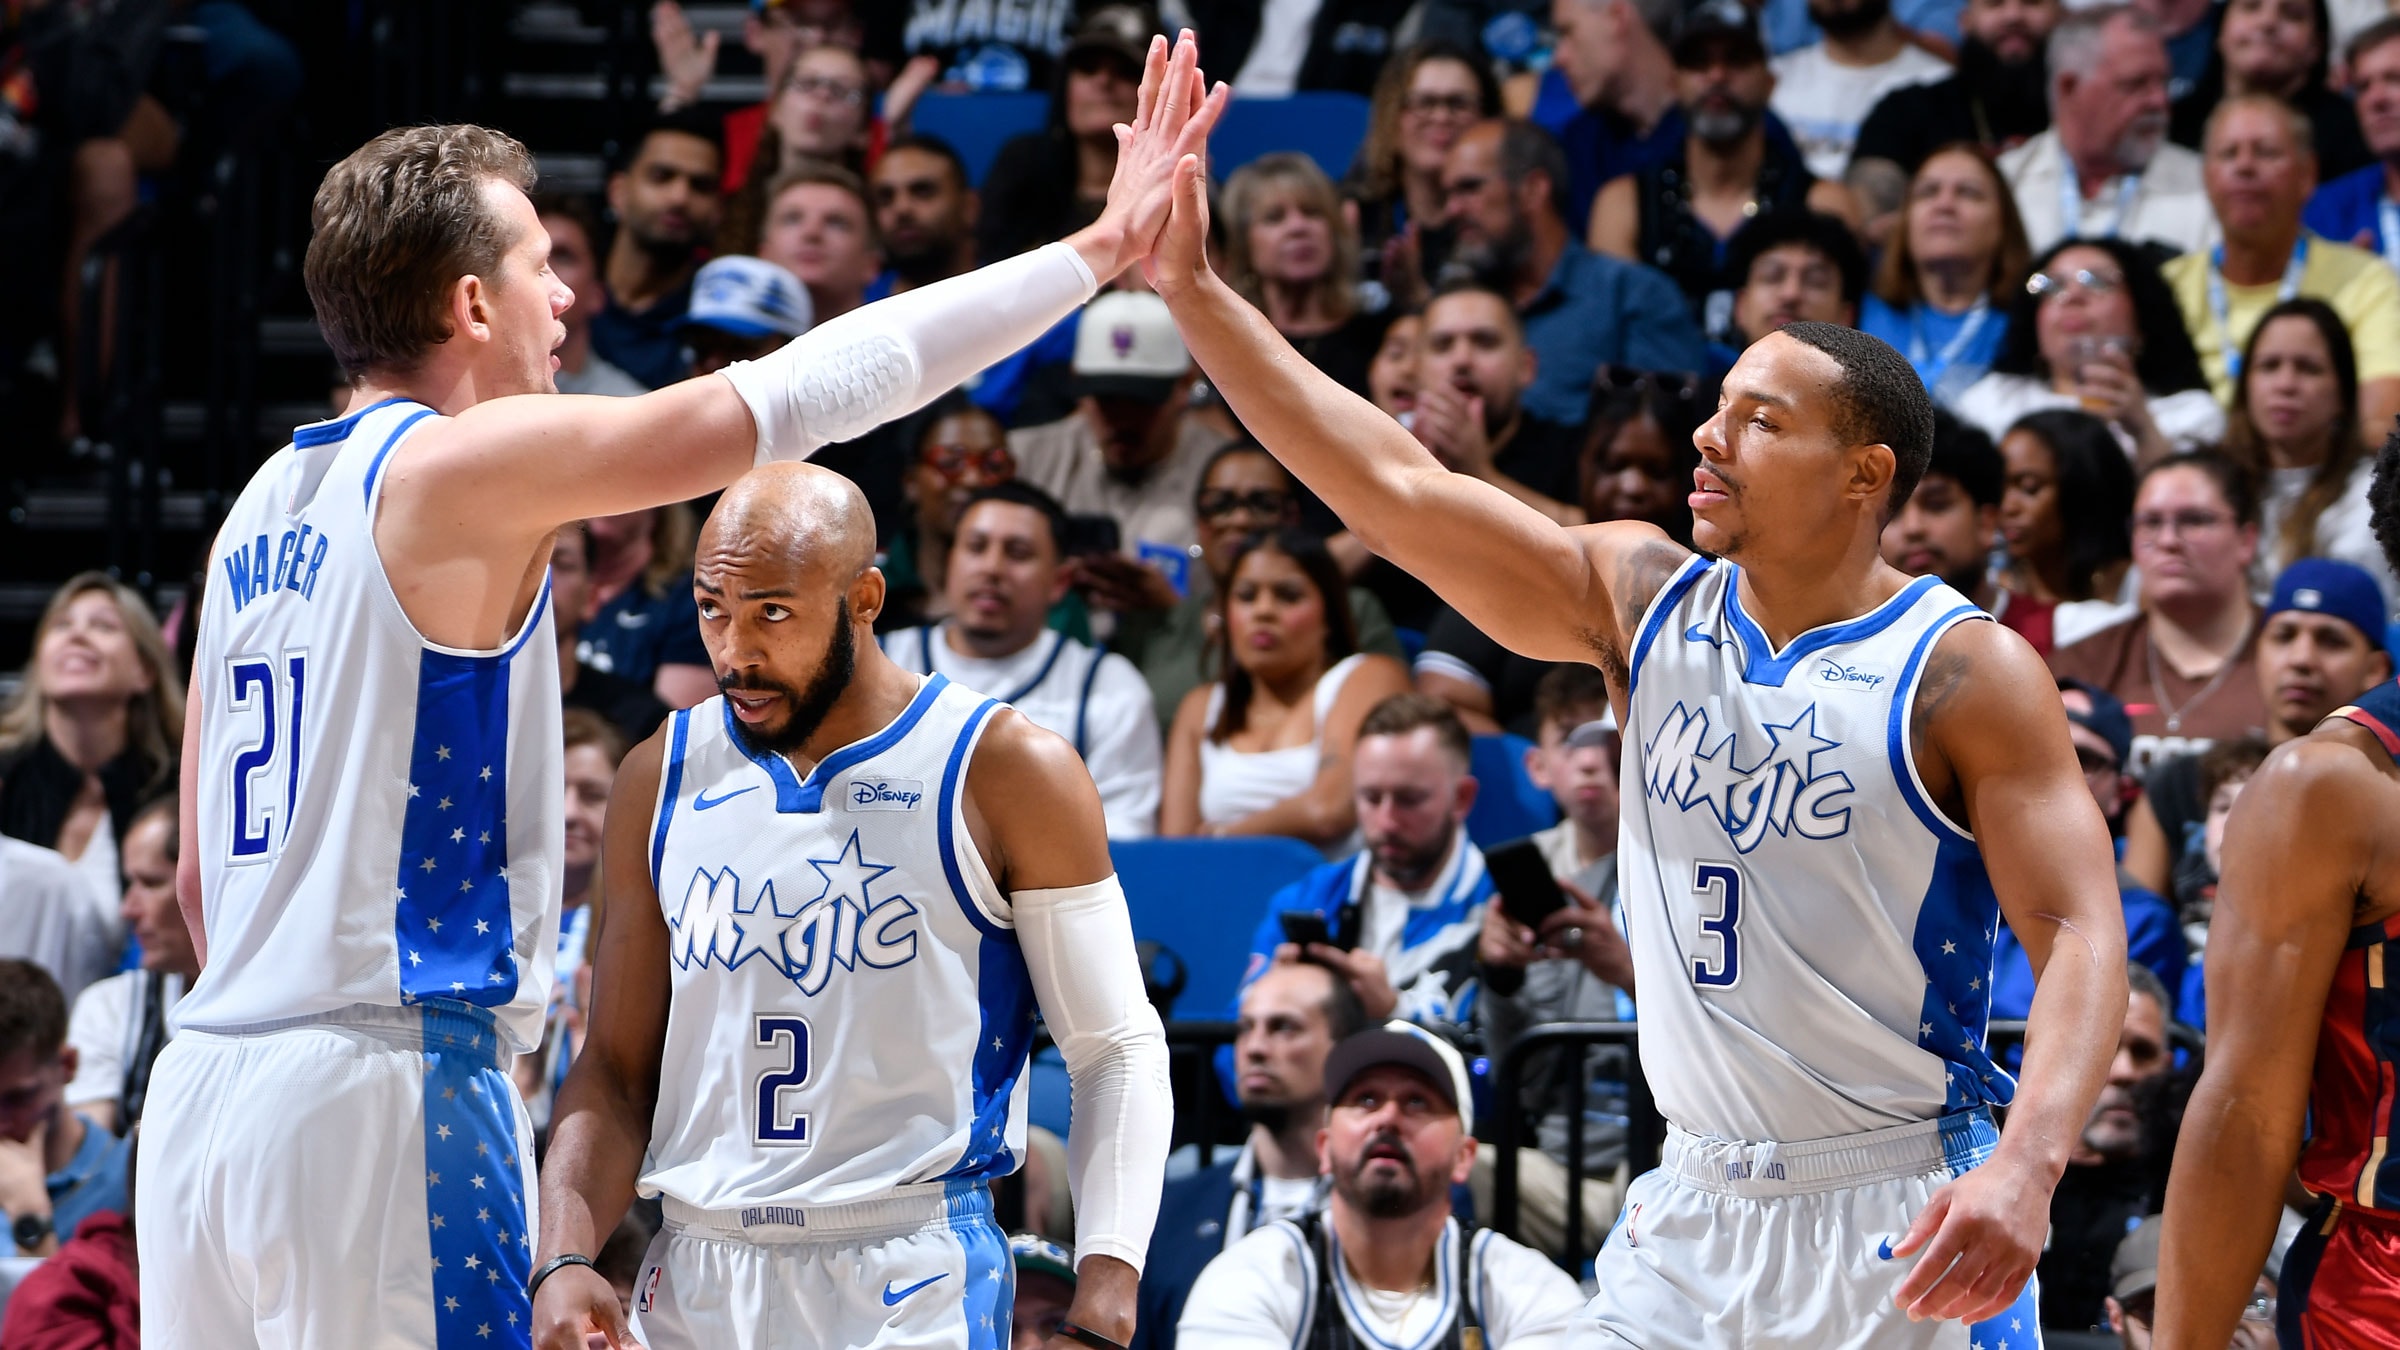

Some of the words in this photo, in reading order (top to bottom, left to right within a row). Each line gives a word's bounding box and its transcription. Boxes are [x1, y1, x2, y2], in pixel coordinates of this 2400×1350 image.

[224, 523, 328, 614] WAGER
[1820, 658, 1884, 690] Disney
[225, 647, 308, 867] 21
[850, 781, 922, 810] Disney
[1691, 858, 1746, 993] 3
[752, 1011, 814, 1147] 2
[1725, 1160, 1786, 1181] ORLADO
[741, 1206, 805, 1228] ORLANDO
